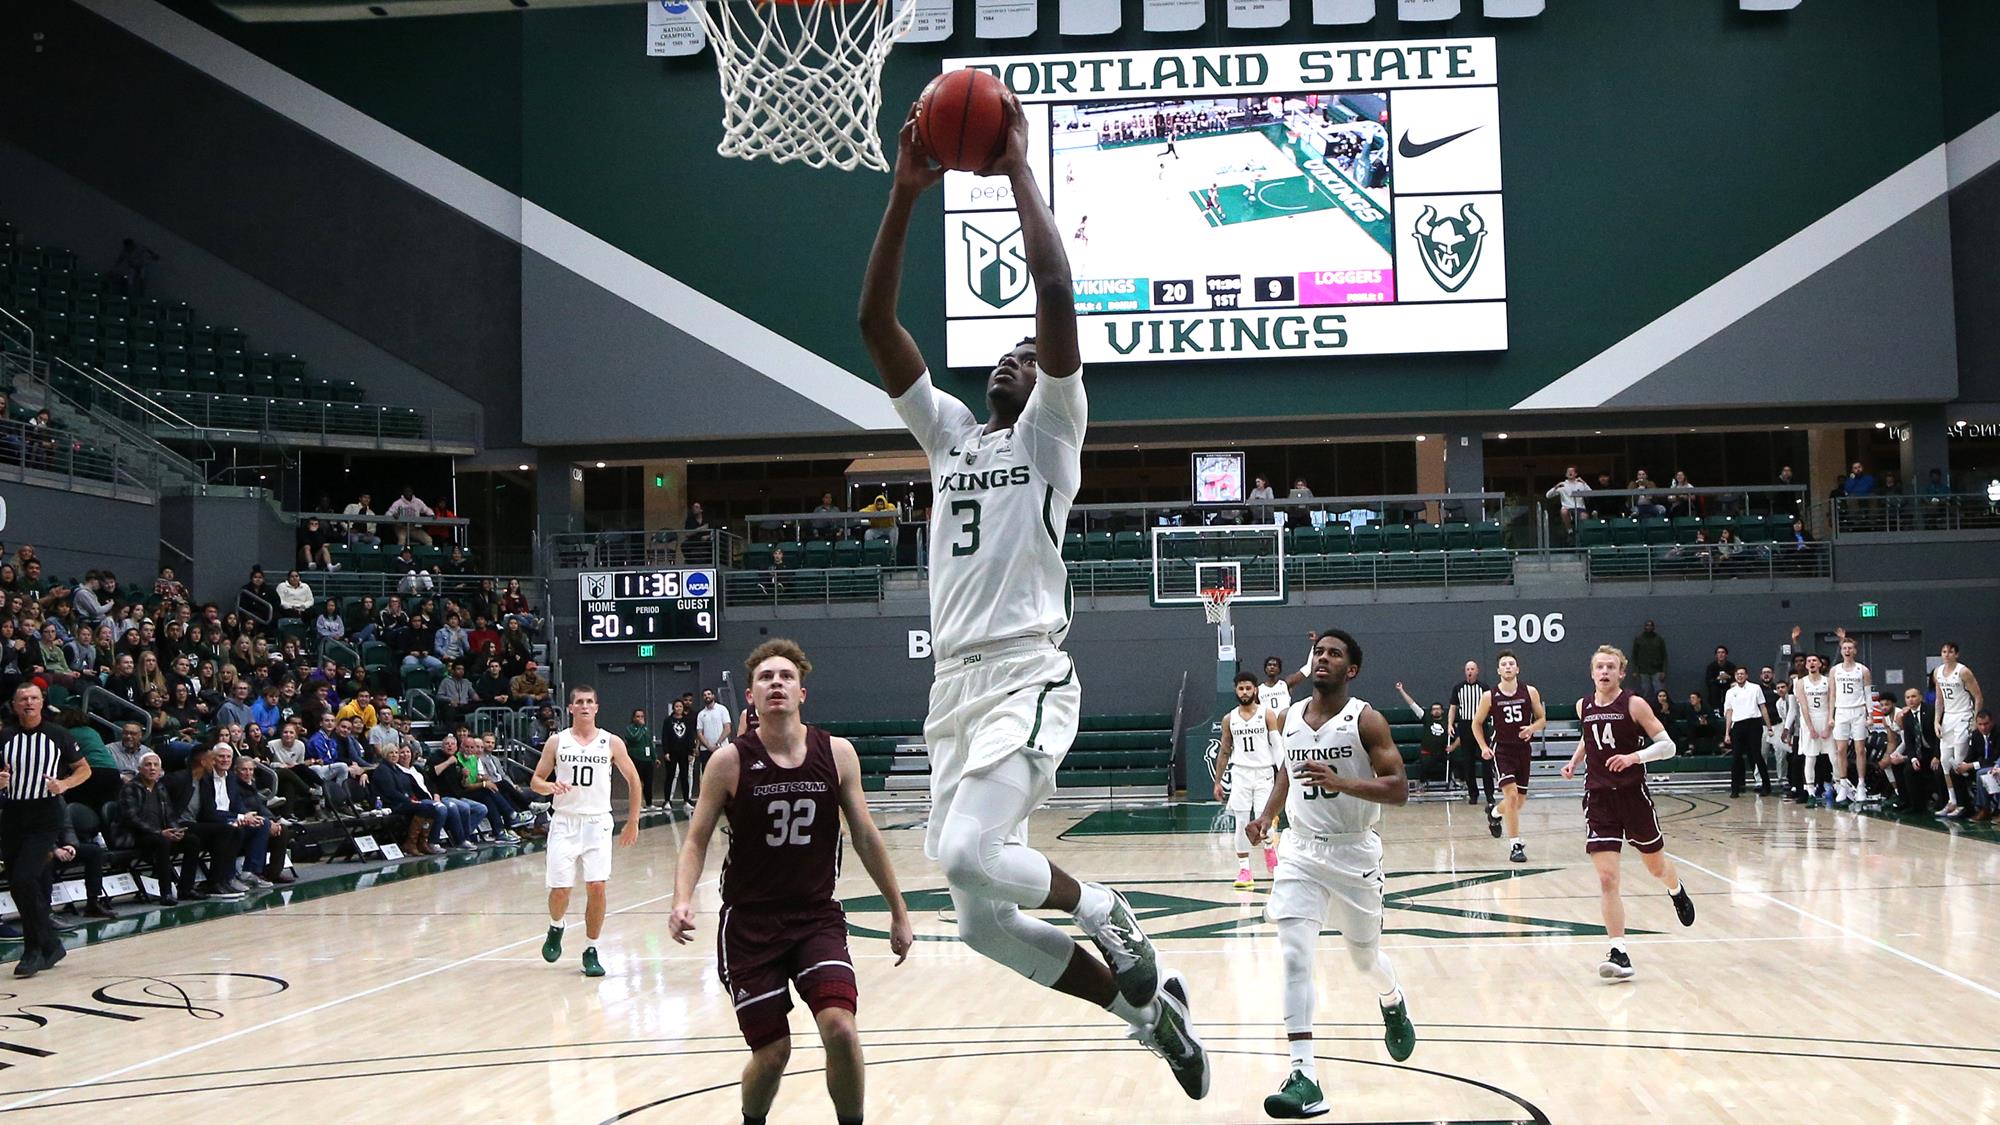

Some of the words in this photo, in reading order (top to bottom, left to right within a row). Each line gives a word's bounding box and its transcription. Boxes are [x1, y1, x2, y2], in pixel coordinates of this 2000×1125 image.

[1299, 45, 1476, 84] STATE
[970, 186, 1015, 202] pep
[1314, 271, 1383, 285] LOGGERS
[1072, 279, 1137, 295] VIKINGS
[1162, 283, 1187, 302] 20
[1268, 279, 1283, 298] 9
[1213, 294, 1237, 307] 1ST
[1104, 314, 1349, 355] VIKINGS
[939, 465, 1031, 494] KINGS
[951, 499, 982, 557] 3
[624, 572, 679, 597] 11:36
[688, 582, 710, 591] NCAA
[588, 601, 617, 612] HOME
[635, 606, 660, 614] PERIOD
[677, 598, 710, 610] GUEST
[590, 614, 620, 638] 20
[648, 616, 654, 633] 1
[696, 611, 712, 634] 9
[1493, 613, 1566, 644] B06
[640, 645, 655, 657] EXIT
[963, 653, 982, 665] PSU
[1843, 682, 1854, 694] 15
[1942, 687, 1955, 700] 12
[1270, 697, 1278, 709] 0
[1813, 697, 1821, 708] 5
[1503, 704, 1523, 723] 35
[1232, 727, 1266, 736] VIKINGS
[1591, 722, 1616, 750] 14
[1243, 736, 1255, 752] 11
[559, 754, 608, 764] VIKINGS
[1287, 745, 1353, 761] VIKINGS
[571, 765, 593, 787] 10
[753, 782, 791, 796] PUGET
[790, 781, 829, 793] SOUND
[766, 798, 817, 847] 32
